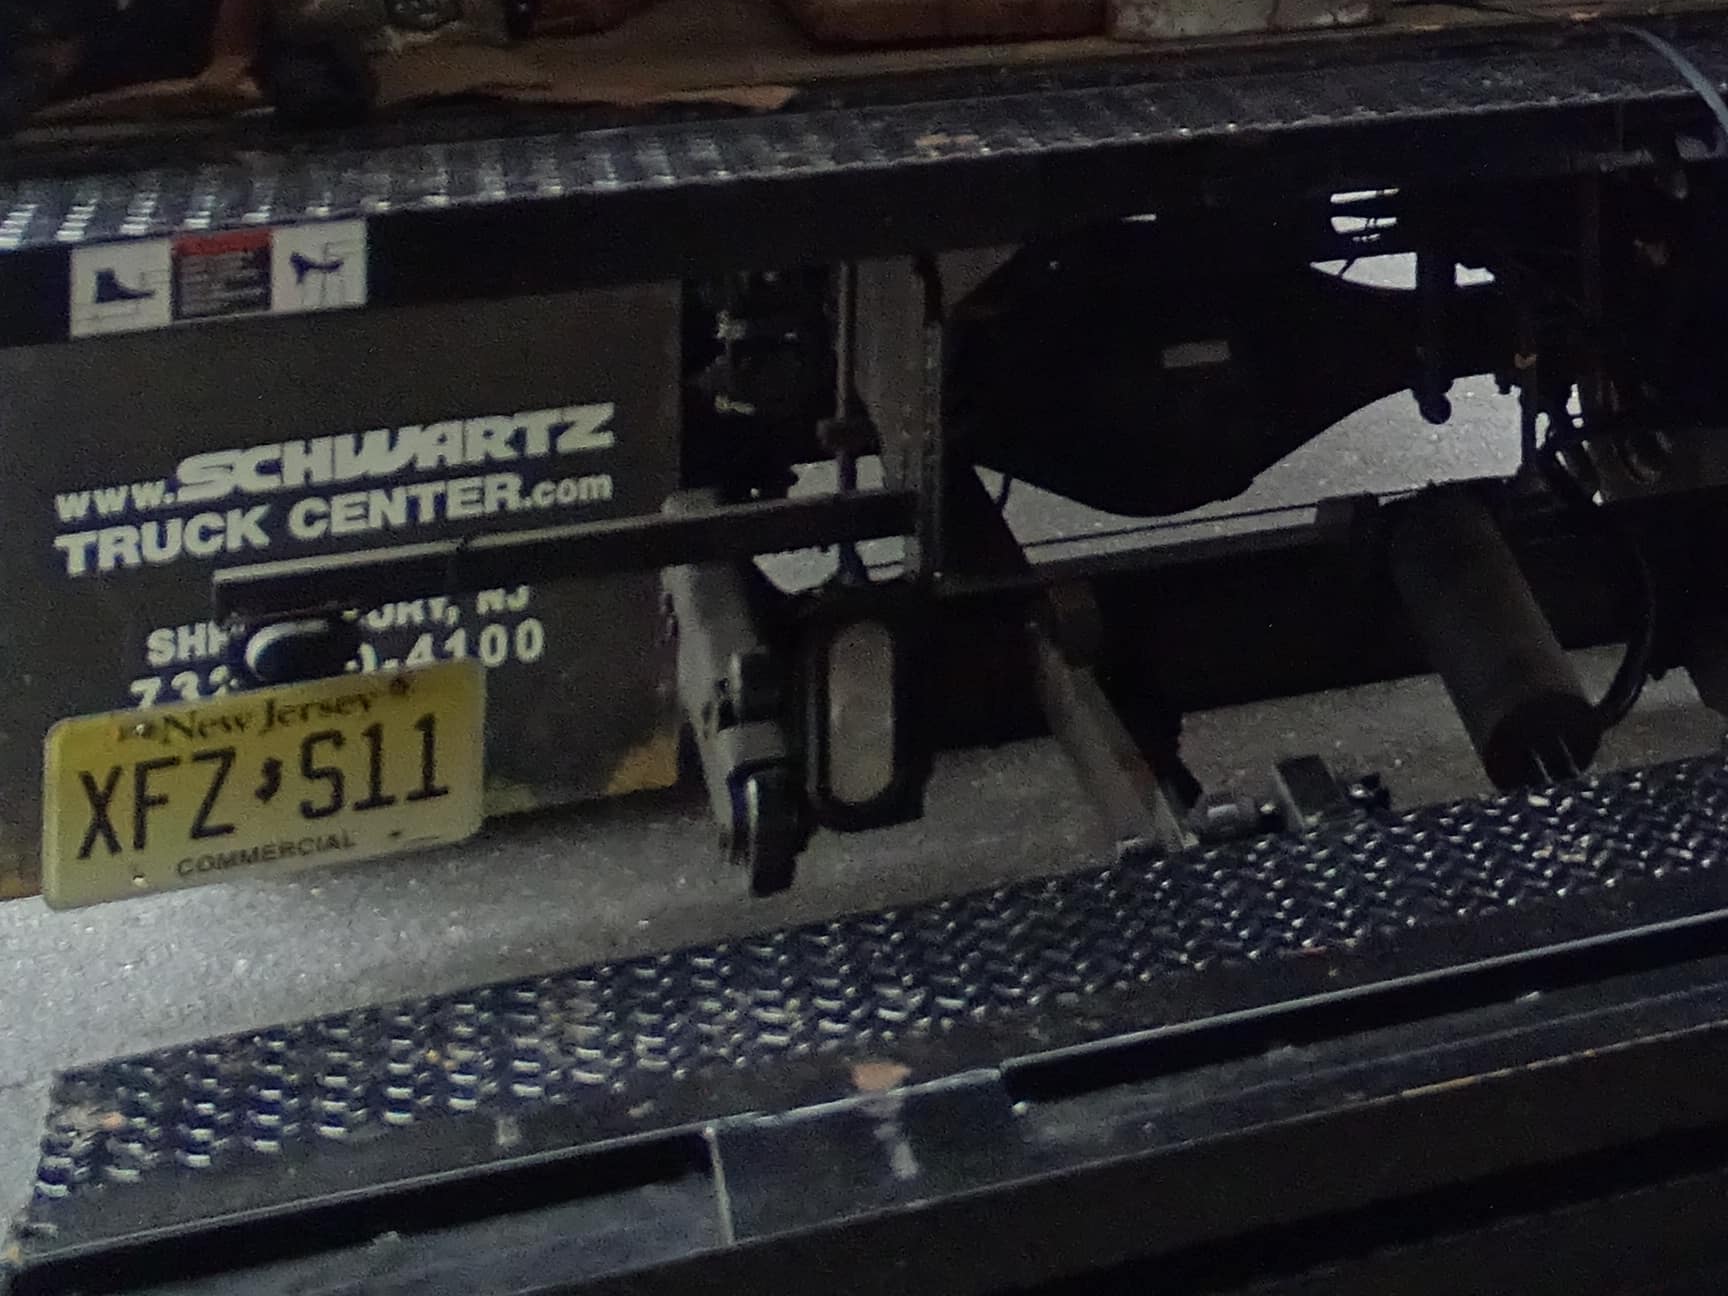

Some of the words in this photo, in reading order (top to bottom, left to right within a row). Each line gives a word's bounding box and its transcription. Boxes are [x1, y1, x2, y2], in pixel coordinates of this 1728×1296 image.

[52, 504, 272, 579] TRUCK
[287, 472, 614, 544] CENTER.com
[77, 745, 237, 861] XFZ
[176, 828, 357, 878] COMMERCIAL
